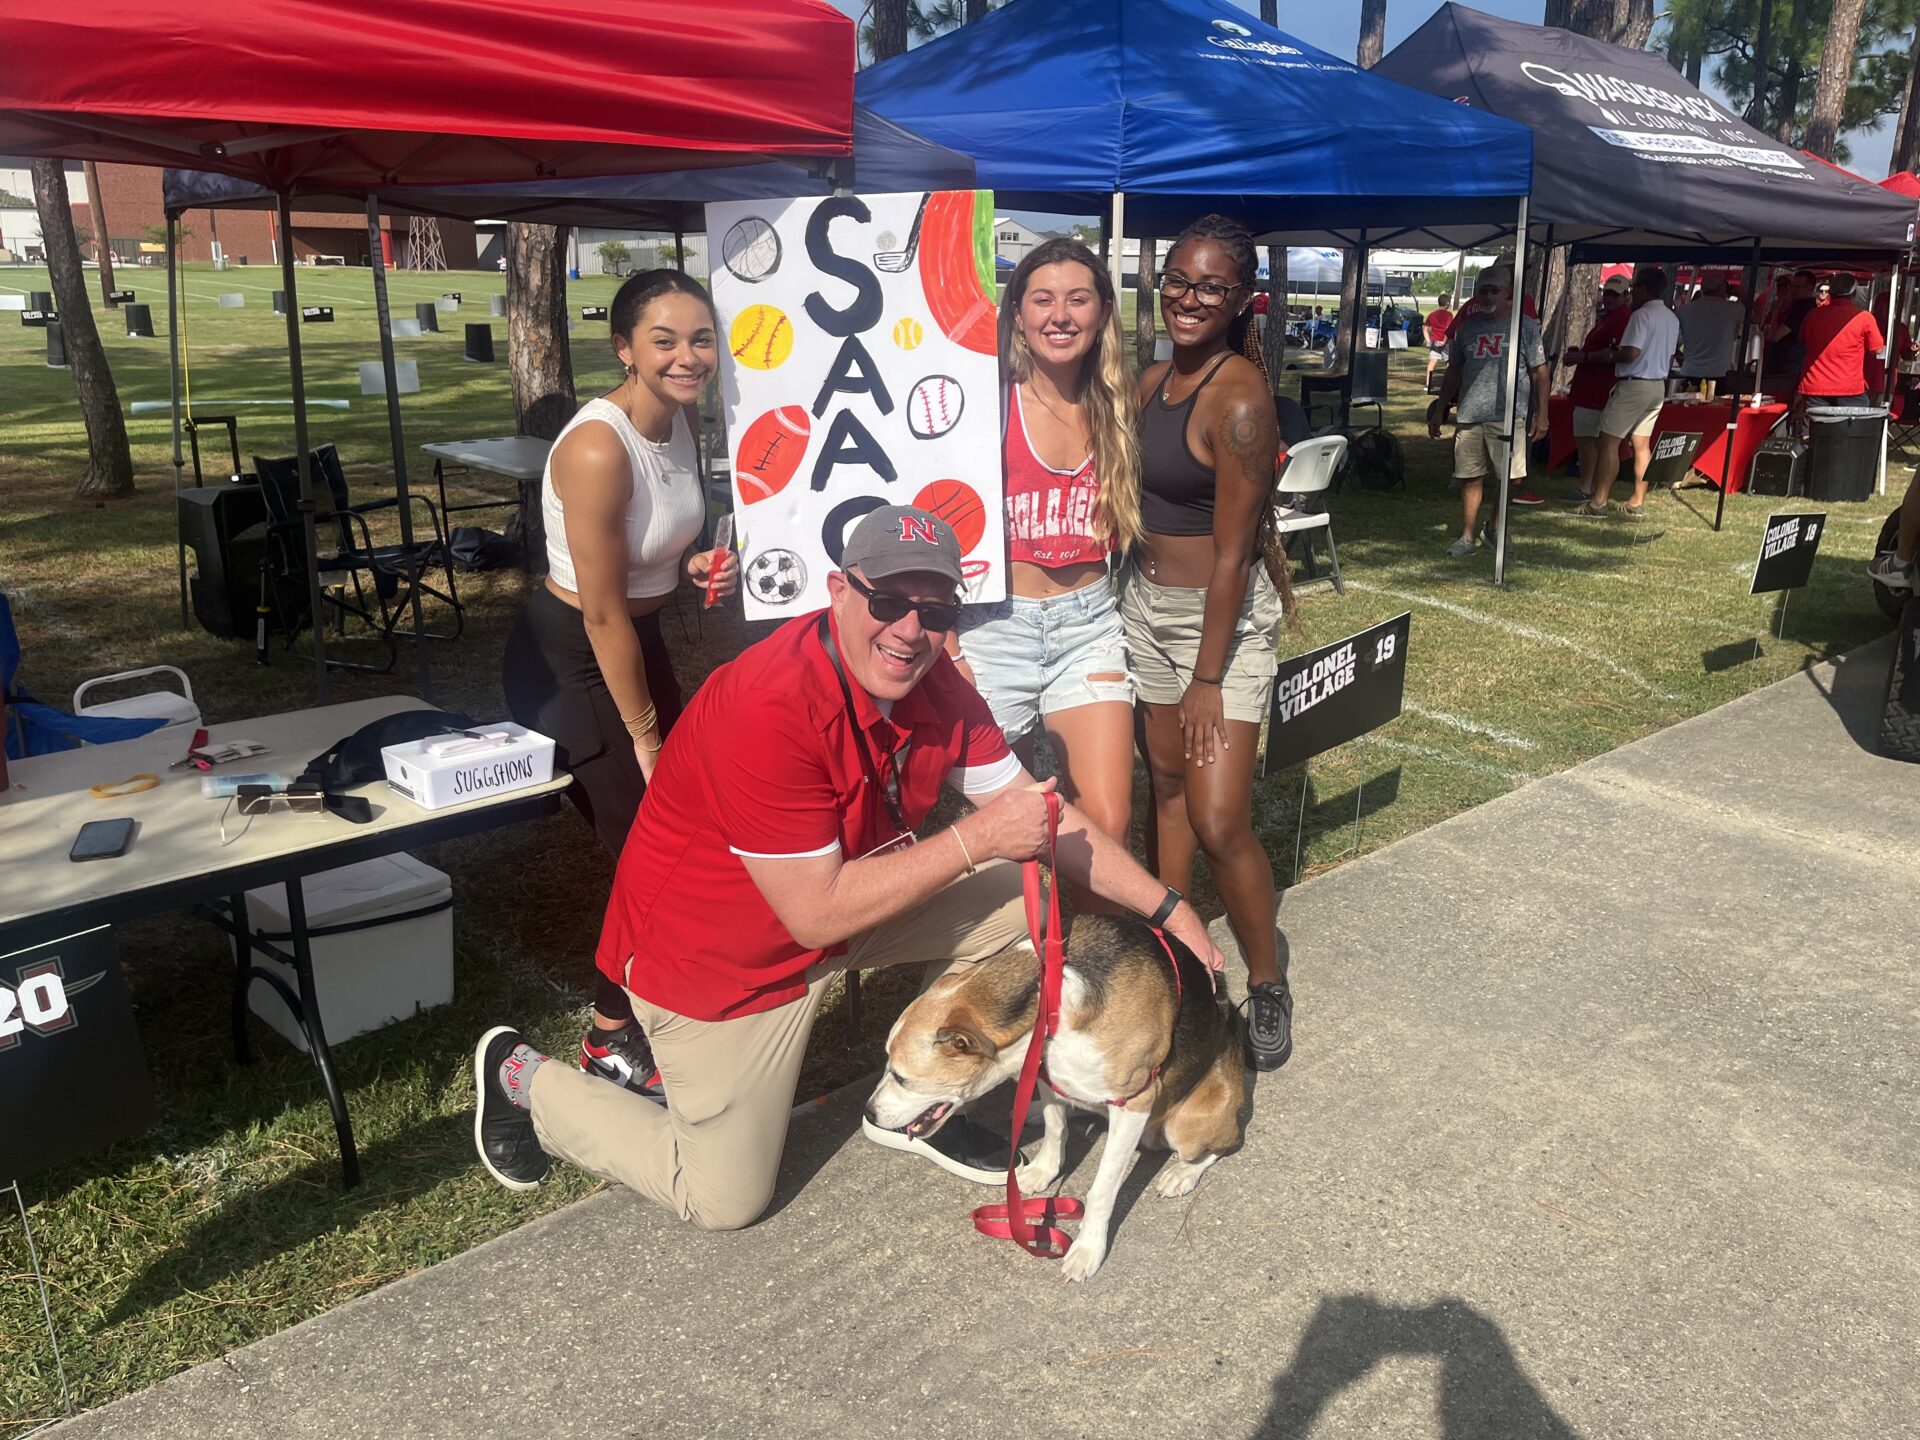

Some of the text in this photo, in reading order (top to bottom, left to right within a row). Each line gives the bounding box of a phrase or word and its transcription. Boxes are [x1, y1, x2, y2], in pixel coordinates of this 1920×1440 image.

[1206, 36, 1304, 56] Gallagher
[1573, 72, 1732, 124] WAGUESPACK
[1720, 129, 1757, 144] INC.
[1655, 445, 1685, 460] VILLAGE
[1658, 435, 1687, 449] COLONEL
[899, 515, 940, 546] N
[1766, 517, 1800, 544] COLONEL
[1804, 523, 1818, 541] 18
[1033, 550, 1055, 560] Est.
[1764, 532, 1799, 560] VILLAGE
[1374, 633, 1396, 664] 19
[1278, 642, 1357, 703] COLONEL
[1279, 661, 1356, 724] VILLAGE
